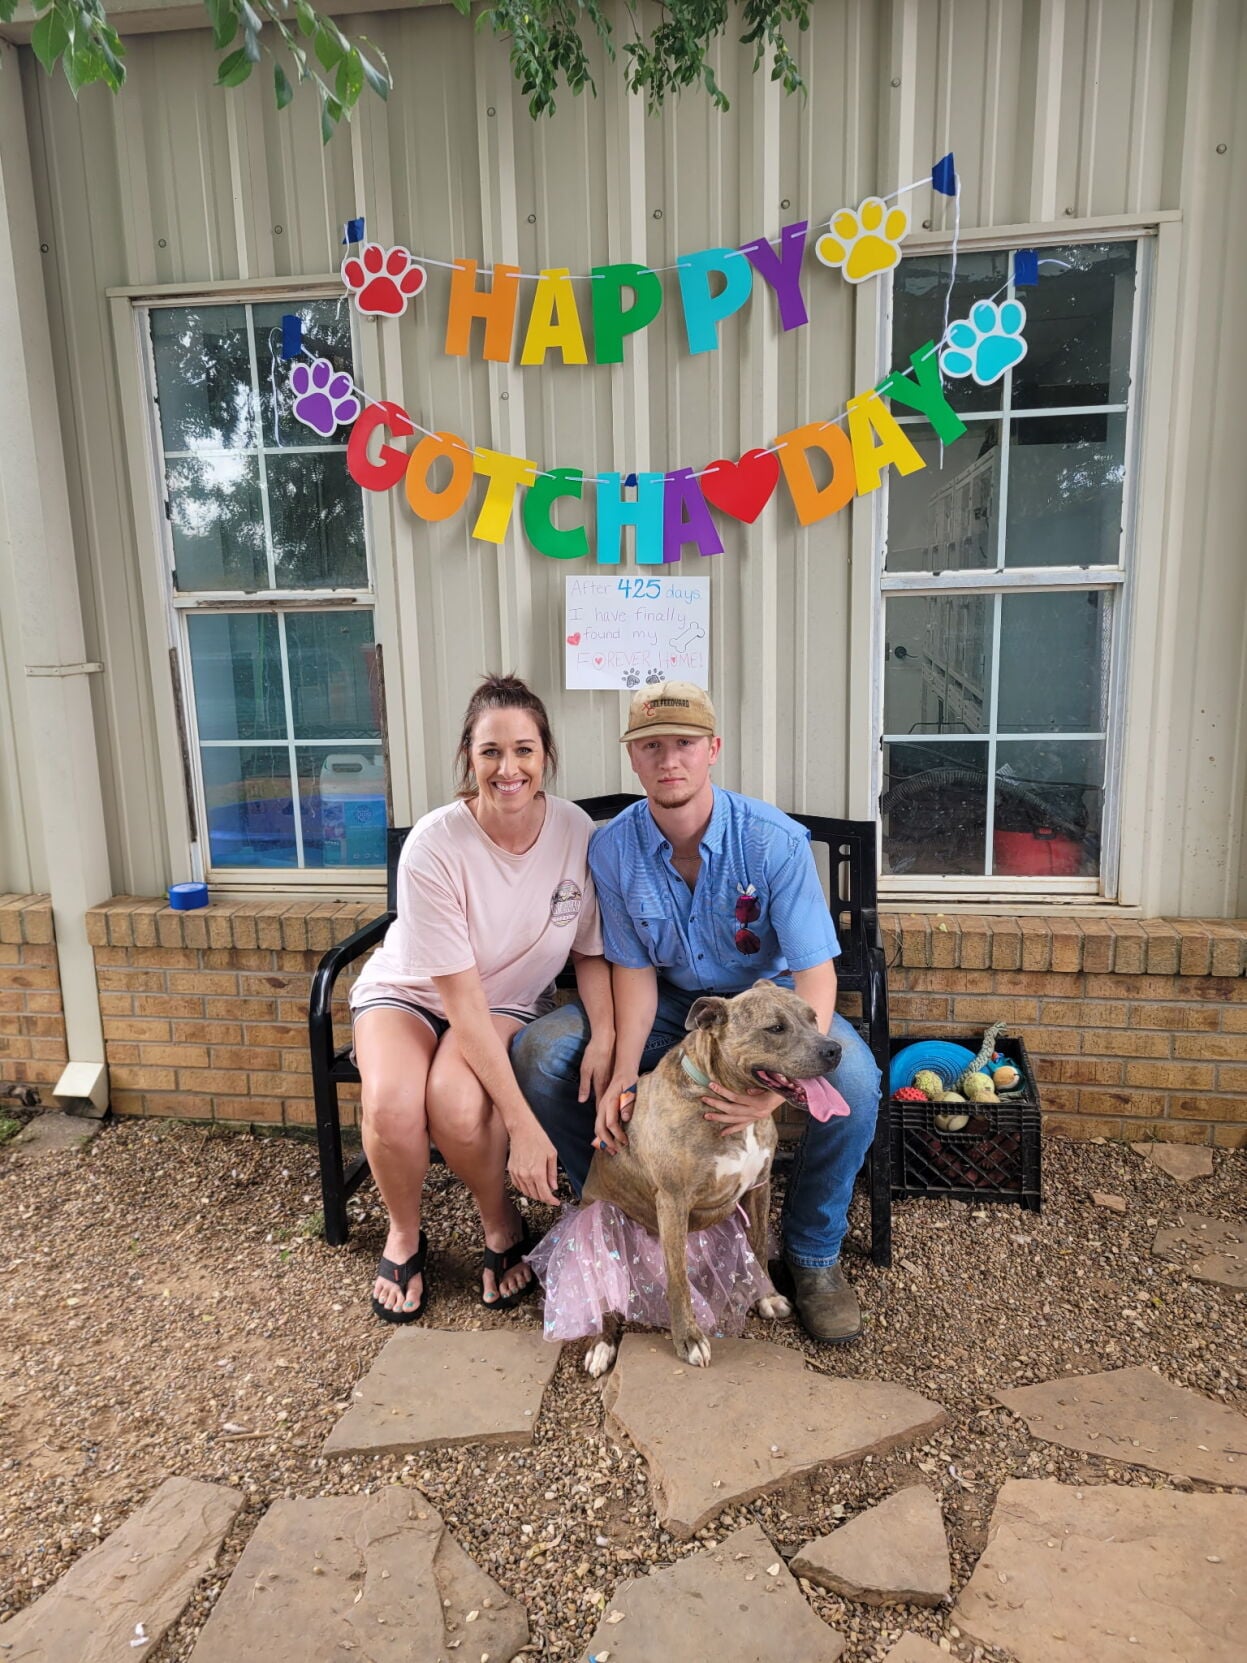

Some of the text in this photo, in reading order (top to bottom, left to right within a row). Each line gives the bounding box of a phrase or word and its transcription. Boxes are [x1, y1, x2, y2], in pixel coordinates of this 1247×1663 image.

[445, 220, 809, 365] HAPPY
[346, 340, 968, 565] GOTCHA DAY
[570, 578, 701, 604] After 425 days
[568, 606, 687, 630] I have finally
[583, 626, 658, 645] found my
[577, 651, 650, 671] FOREVER
